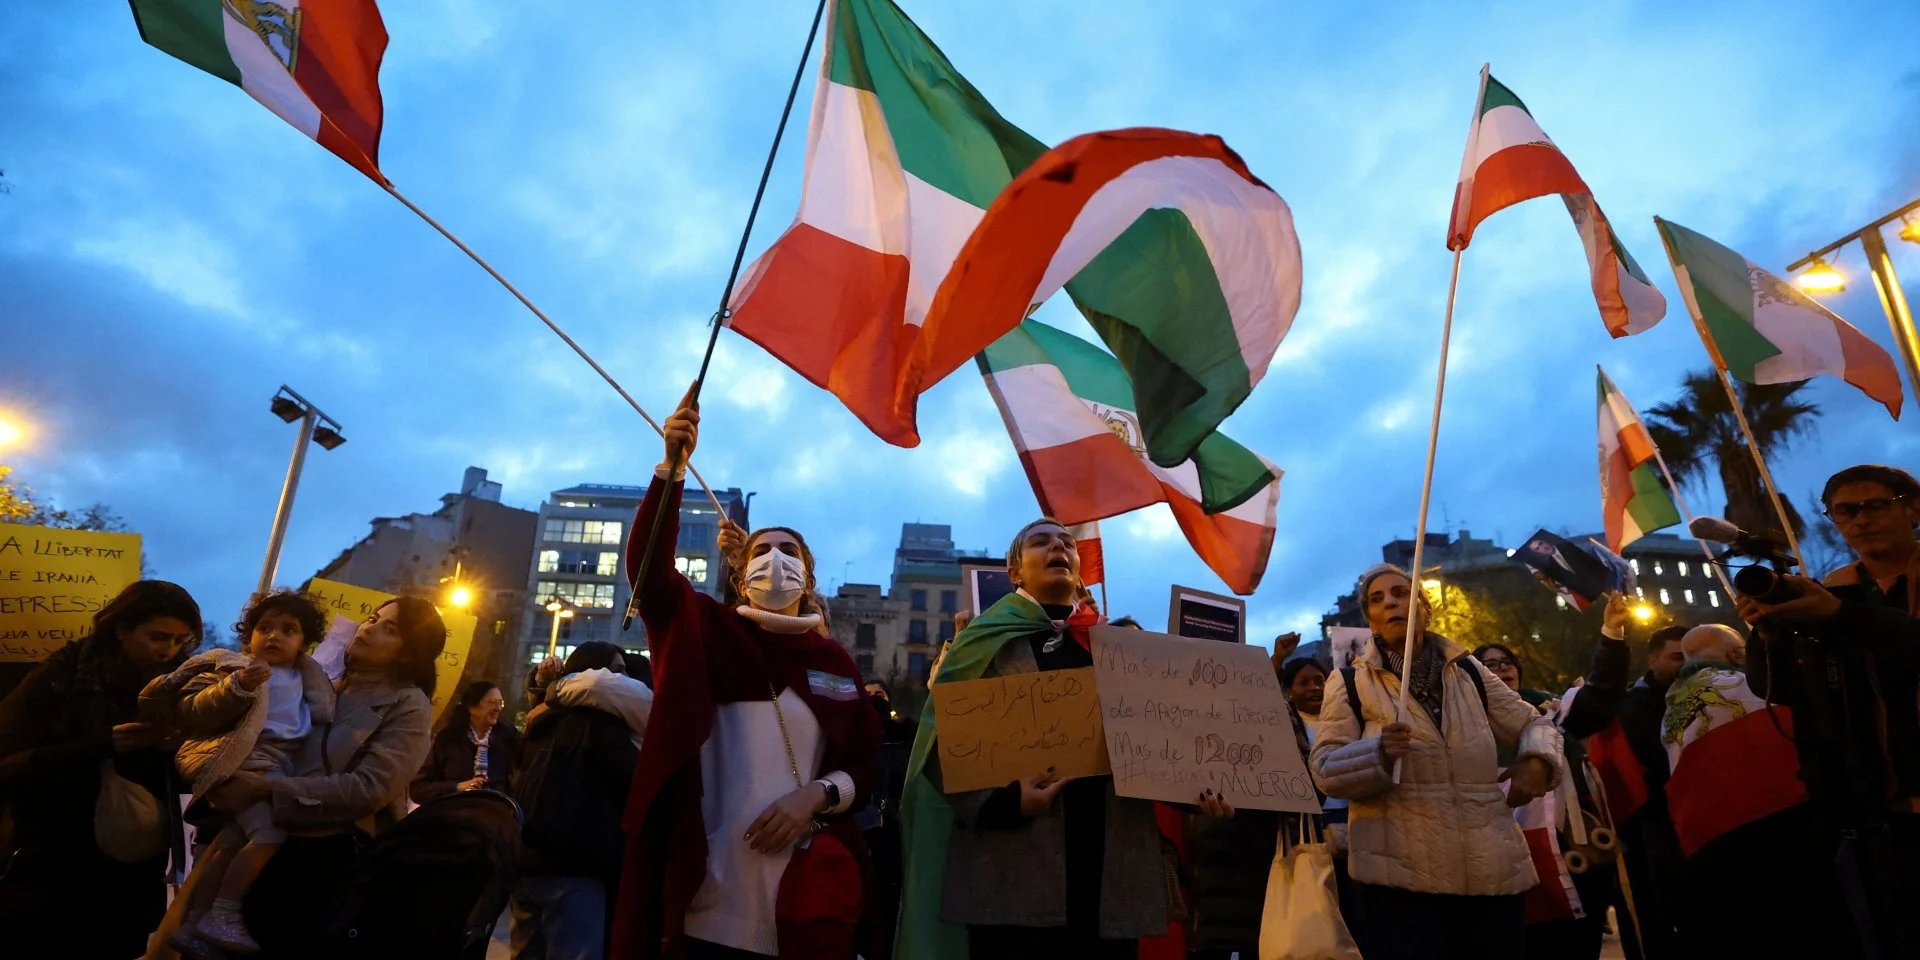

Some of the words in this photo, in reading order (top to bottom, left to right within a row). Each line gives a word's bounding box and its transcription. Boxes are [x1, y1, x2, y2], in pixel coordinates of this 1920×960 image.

[330, 593, 352, 611] de
[1161, 657, 1185, 679] de
[1191, 658, 1228, 685] 100
[1110, 695, 1136, 719] de
[1205, 703, 1224, 720] de
[1160, 738, 1185, 761] de
[1220, 770, 1316, 801] MUERTOS
